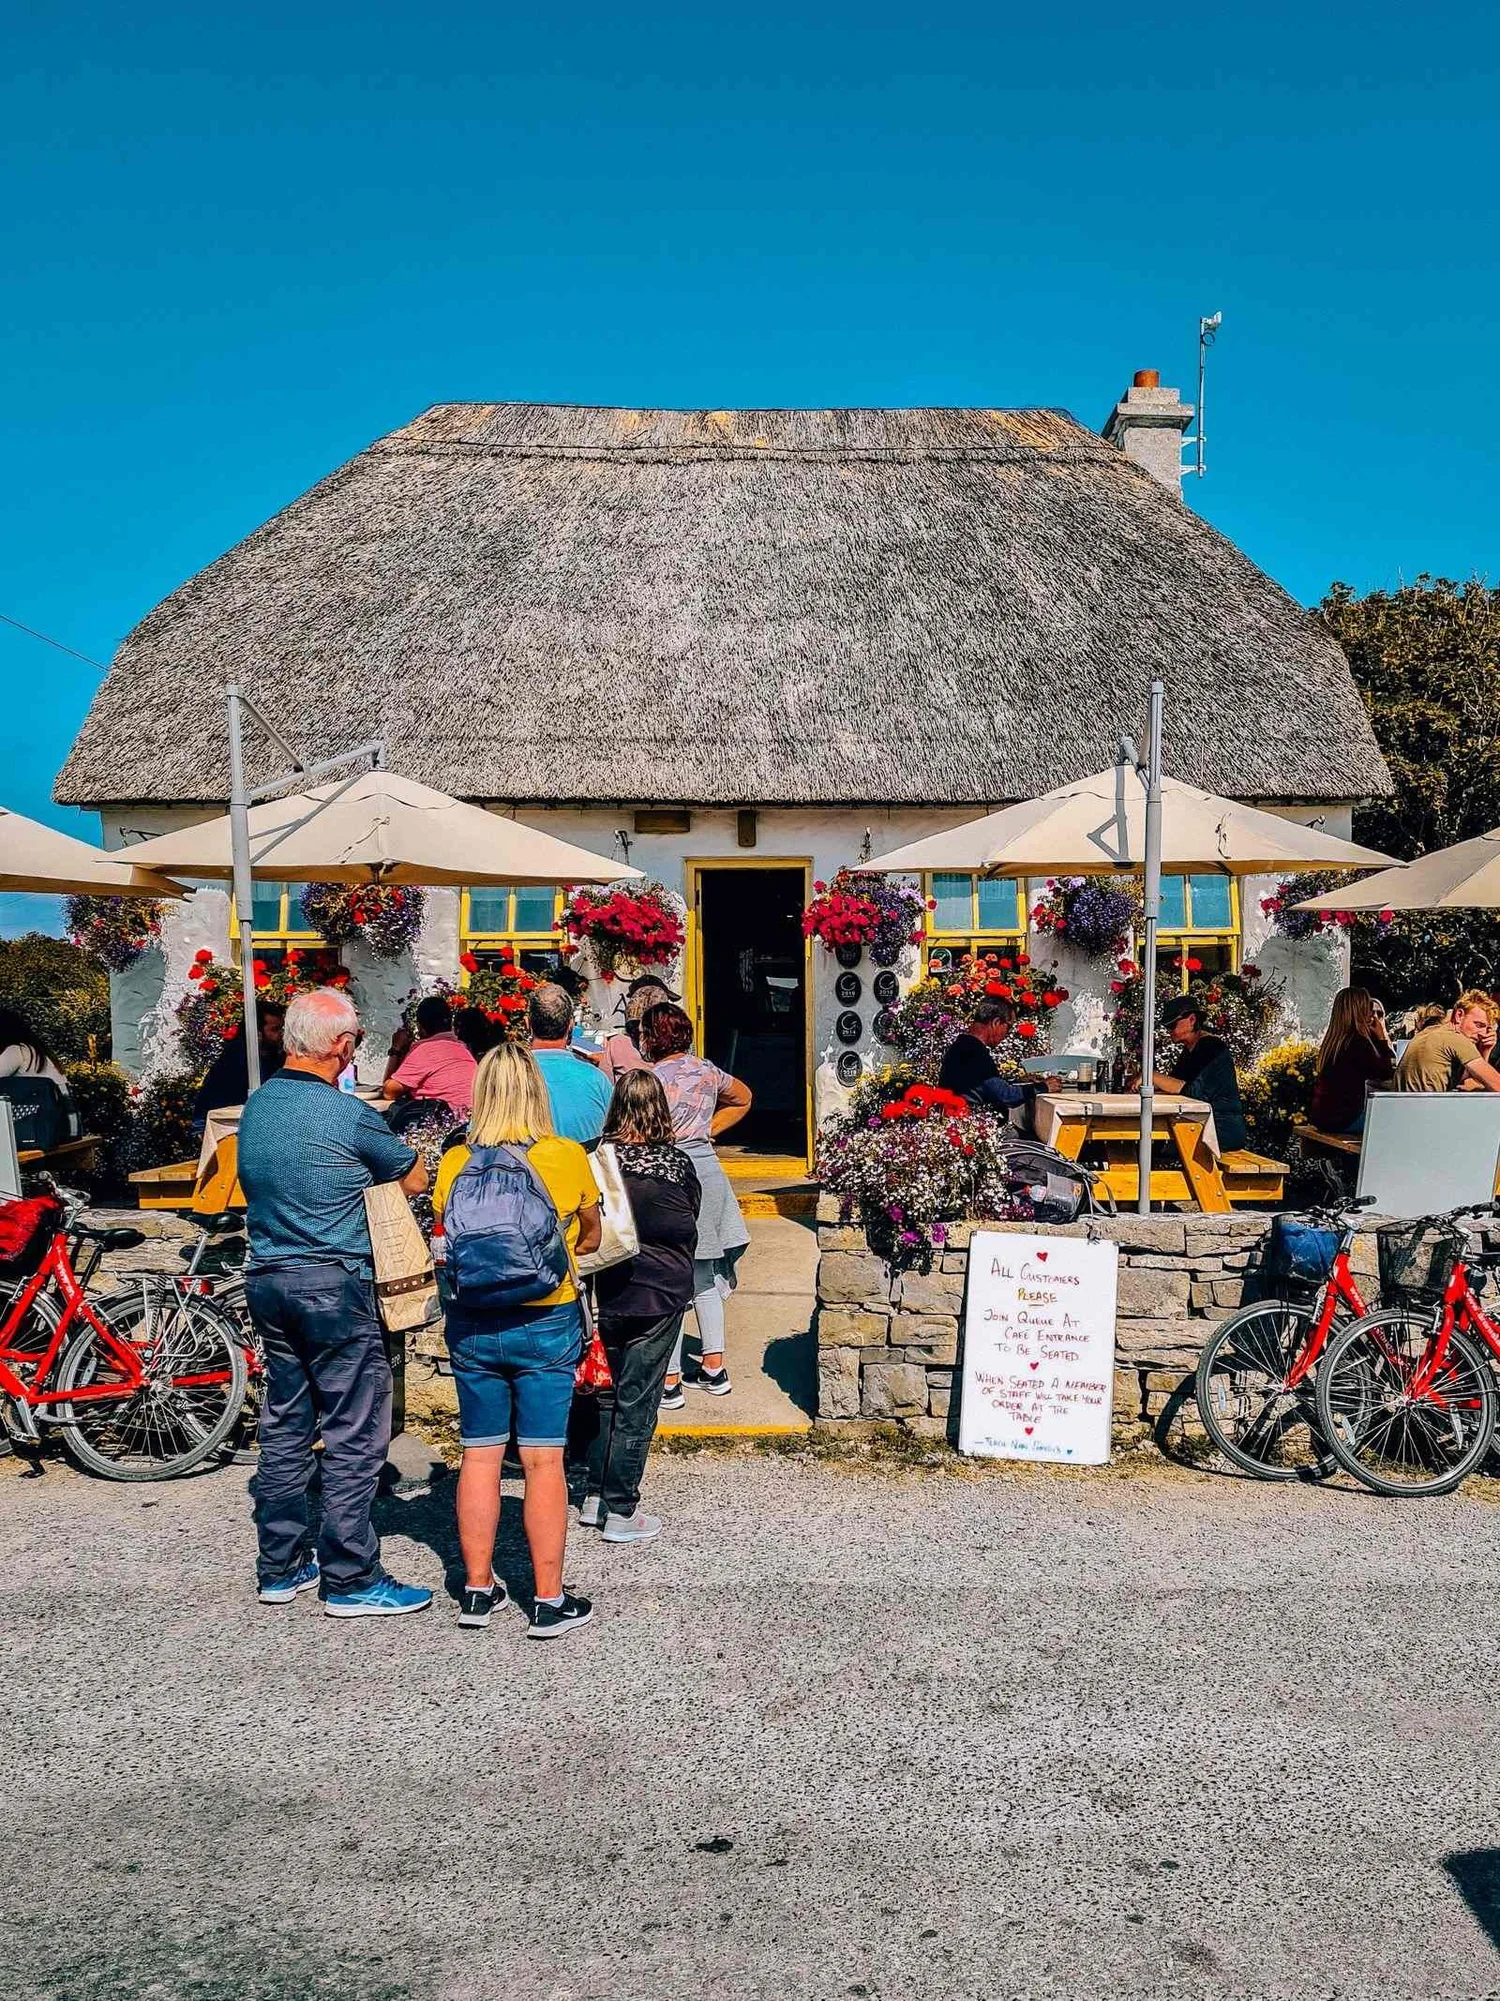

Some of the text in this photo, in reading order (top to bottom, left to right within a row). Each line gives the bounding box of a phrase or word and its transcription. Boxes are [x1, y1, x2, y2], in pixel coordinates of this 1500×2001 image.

[991, 1257, 1080, 1286] ALL CUSTOMERS
[1017, 1287, 1058, 1303] PLEASE
[983, 1308, 1080, 1328] JOIN QUEUE AT
[1037, 1330, 1090, 1342] ENTRANCE
[993, 1342, 1079, 1361] TO BE SEATED
[975, 1371, 1107, 1393] WHEN SEATED A MEMBER
[981, 1386, 1103, 1405] OF STAFF WILL TAKE YOUR
[991, 1399, 1069, 1415] ORDER AT THE
[1008, 1411, 1042, 1424] TABLE
